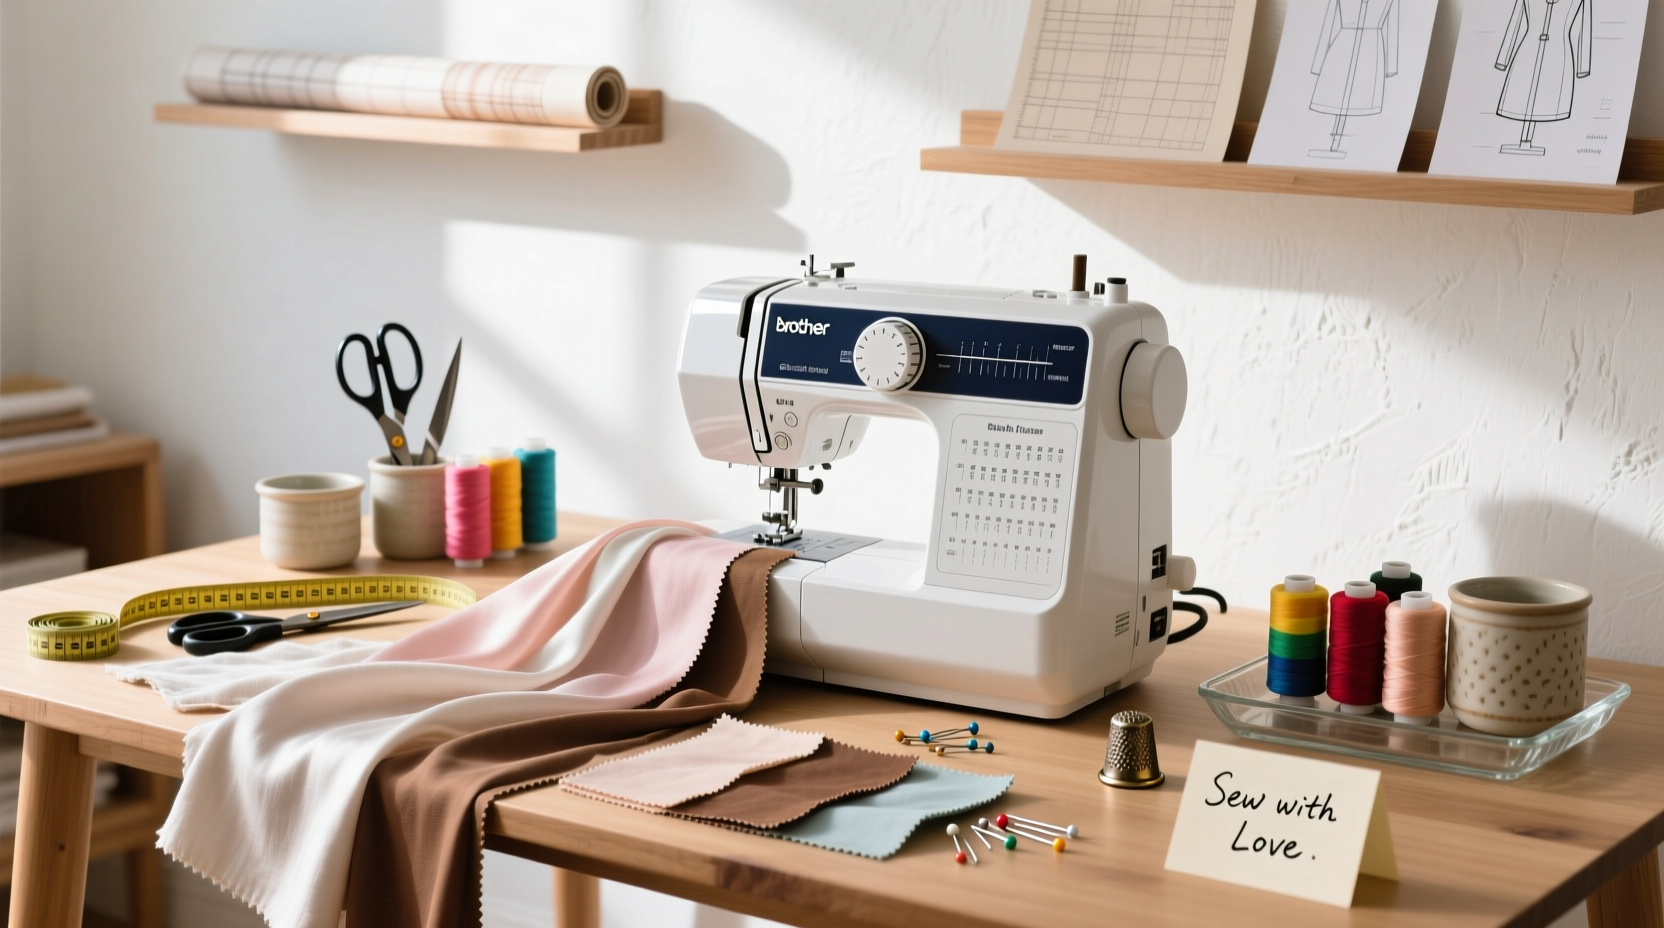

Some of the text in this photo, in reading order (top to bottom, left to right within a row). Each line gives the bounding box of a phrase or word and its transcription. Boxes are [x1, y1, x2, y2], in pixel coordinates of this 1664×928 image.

[1205, 771, 1337, 822] Sew with
[1231, 820, 1316, 860] Love.
